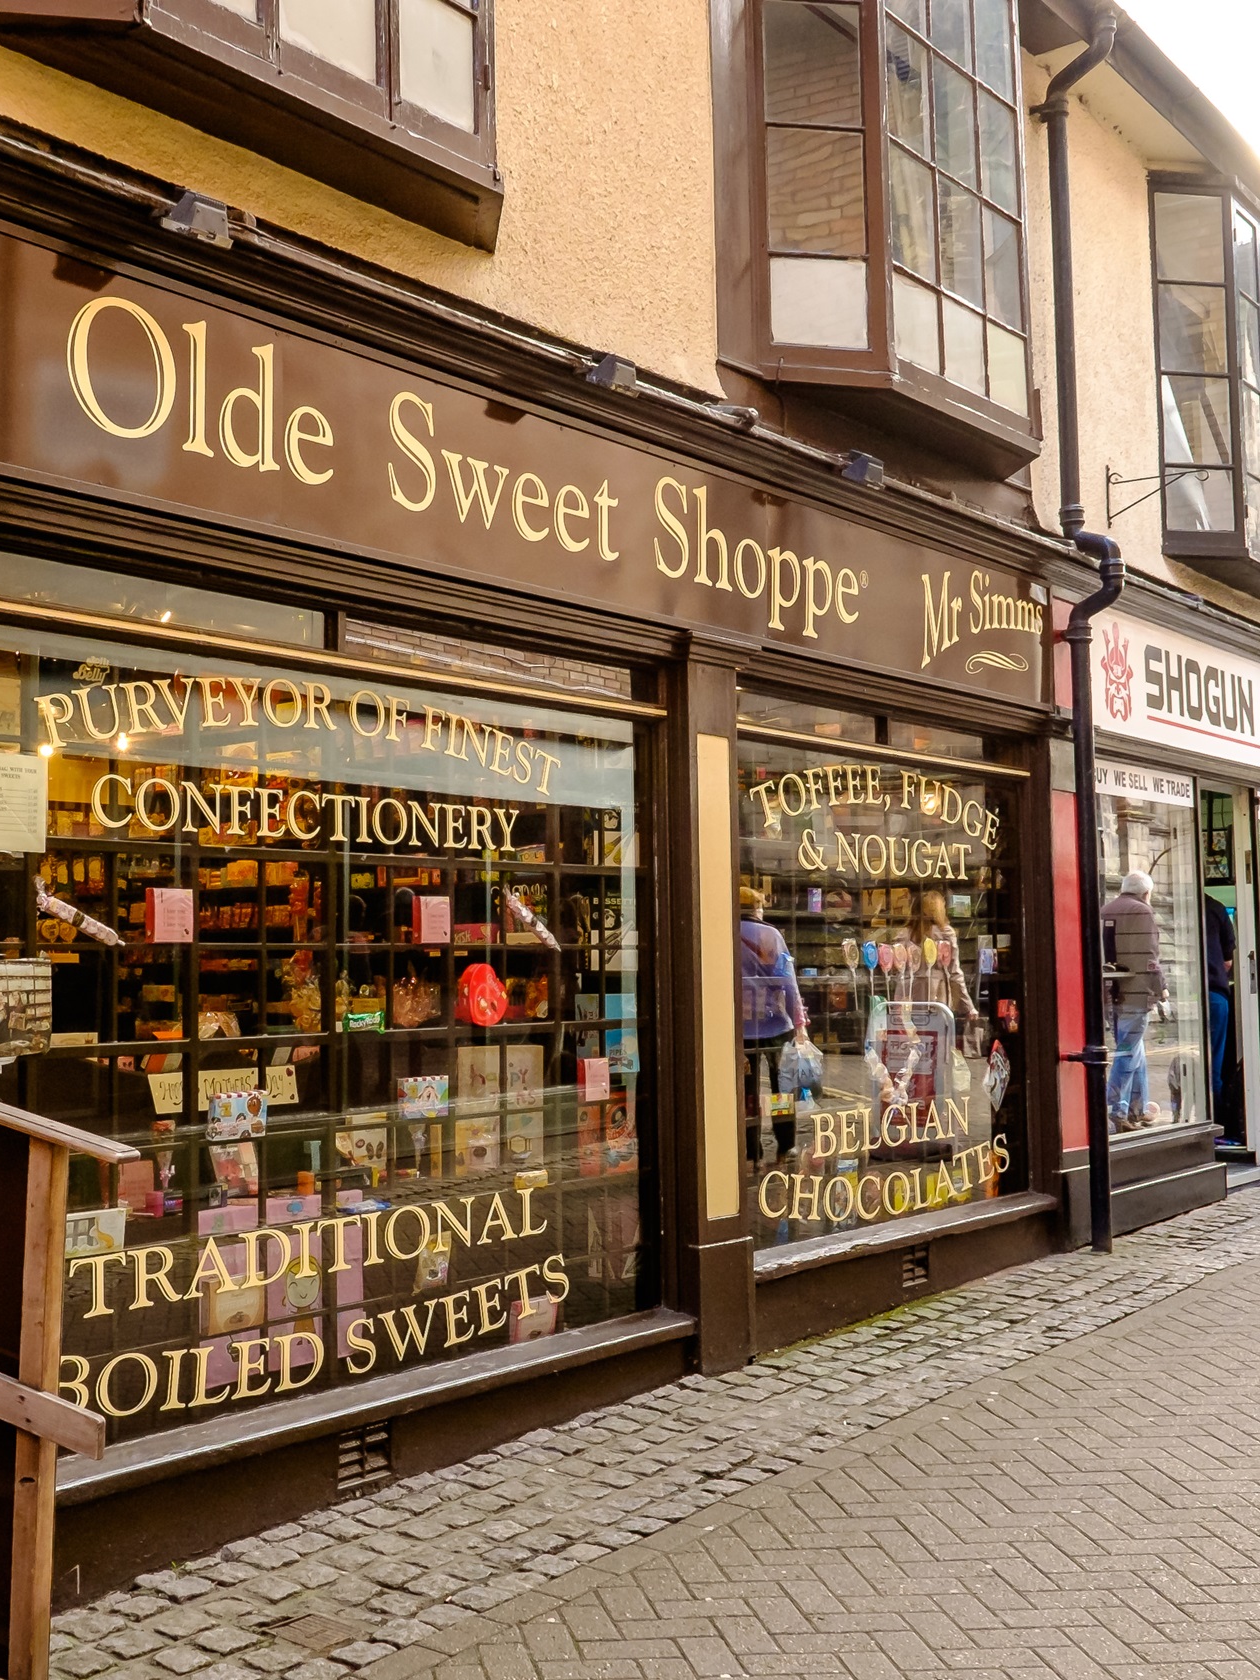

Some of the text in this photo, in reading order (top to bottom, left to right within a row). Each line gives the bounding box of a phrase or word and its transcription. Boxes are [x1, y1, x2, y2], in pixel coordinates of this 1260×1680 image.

[66, 297, 334, 485] Olde
[388, 391, 619, 562] Sweet
[921, 570, 1043, 669] Mr Simms
[73, 664, 106, 685] Belly
[1144, 645, 1255, 737] SHOGUN
[34, 678, 561, 797] PURVEYOR OF FINEST
[91, 774, 520, 852] CONFECTIONERY
[749, 765, 1000, 850] TOFFEE, FUDGE
[1095, 766, 1191, 798] UY WE SELL WE TRADE
[798, 829, 971, 880] & NOUGAT
[203, 1075, 251, 1100] MOTHERS
[810, 1097, 970, 1158] BELGIAN
[759, 1133, 1010, 1221] CHOCOLATES
[69, 1187, 548, 1320] TRADITIONAL
[347, 1254, 570, 1375] SWEETS
